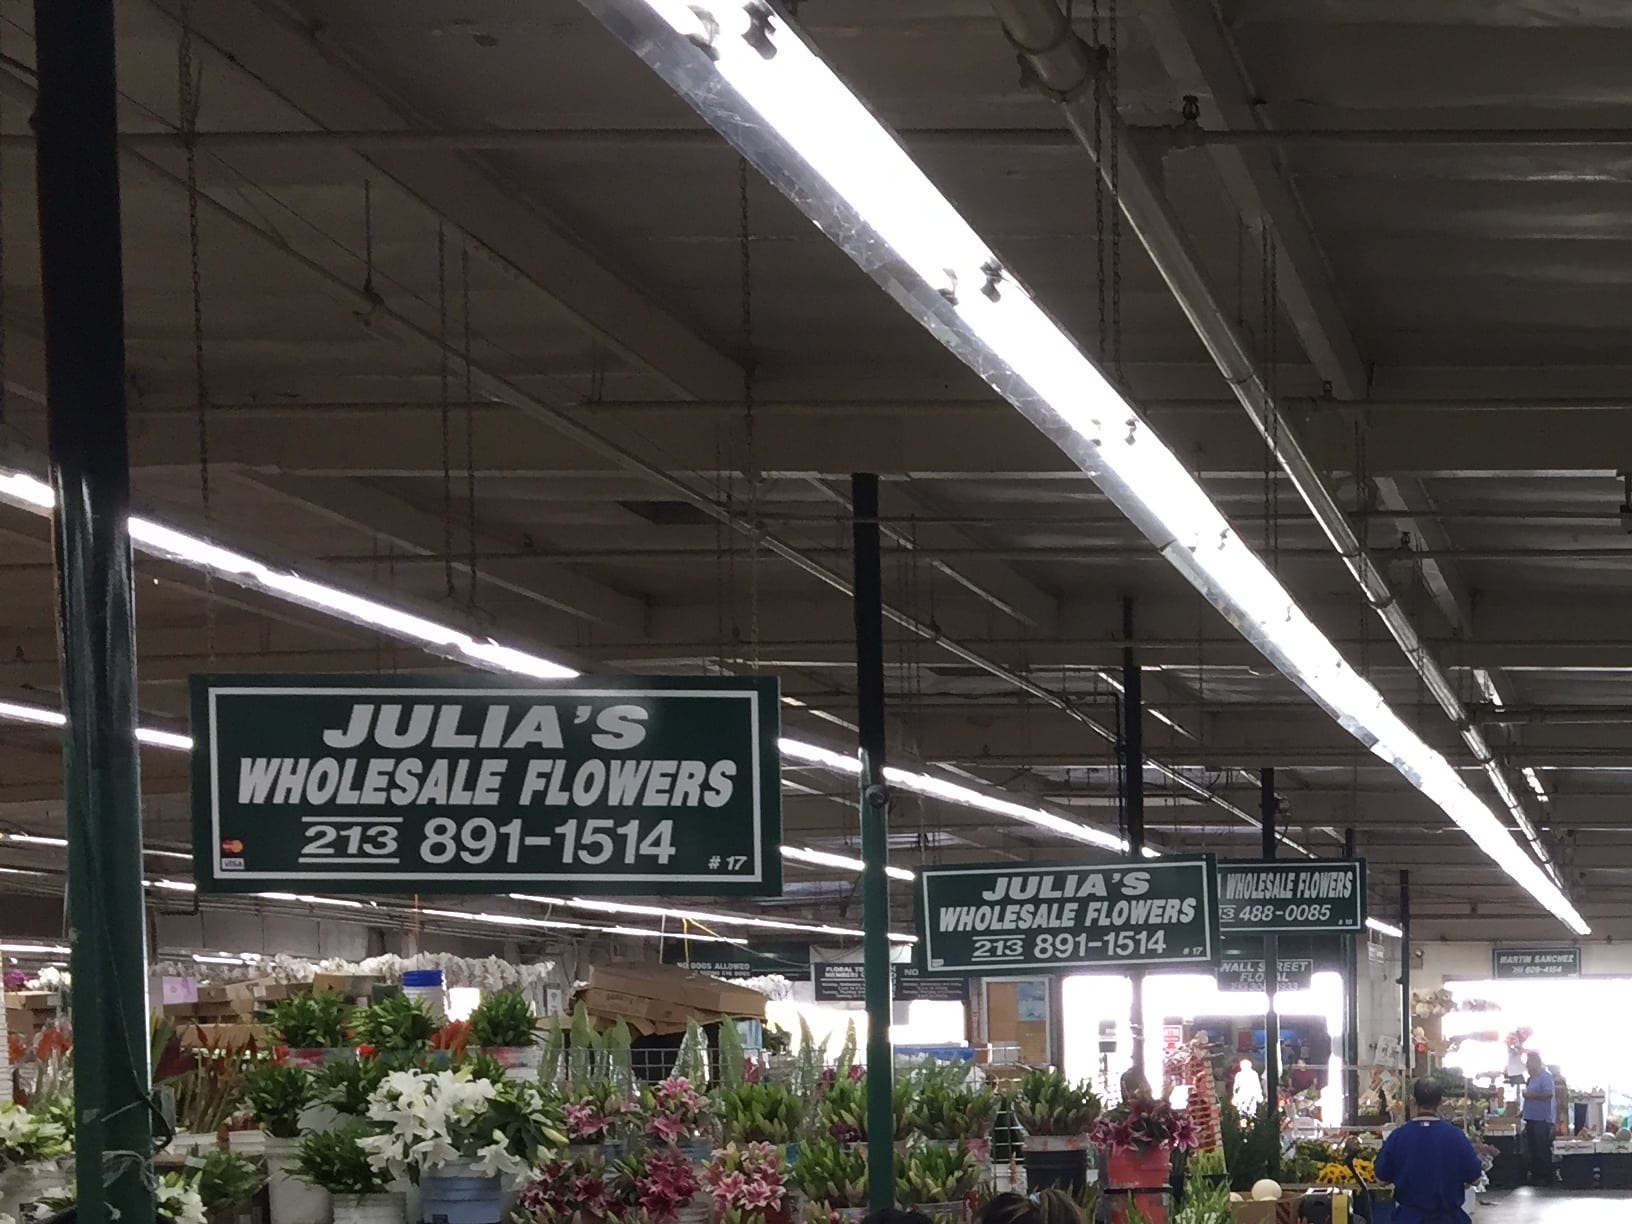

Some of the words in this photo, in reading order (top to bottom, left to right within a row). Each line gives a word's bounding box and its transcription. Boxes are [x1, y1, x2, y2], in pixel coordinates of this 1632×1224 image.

[322, 703, 649, 749] JULIA'S
[238, 757, 508, 805] WHOLESALE
[519, 758, 738, 808] FLOWERS
[300, 825, 400, 856] 213
[419, 816, 677, 865] 891-1514
[982, 871, 1151, 901] JULIA'S
[1226, 872, 1296, 899] WHOLESALE
[1297, 872, 1353, 899] FLOWERS
[939, 902, 1078, 932] WHOLESALE
[1084, 898, 1197, 927] FLOWERS
[1239, 904, 1331, 922] 488-0085
[972, 939, 1024, 957] 213
[1033, 930, 1167, 959] 891-1514
[714, 962, 751, 970] ALLOWED
[1257, 961, 1308, 973] SREET
